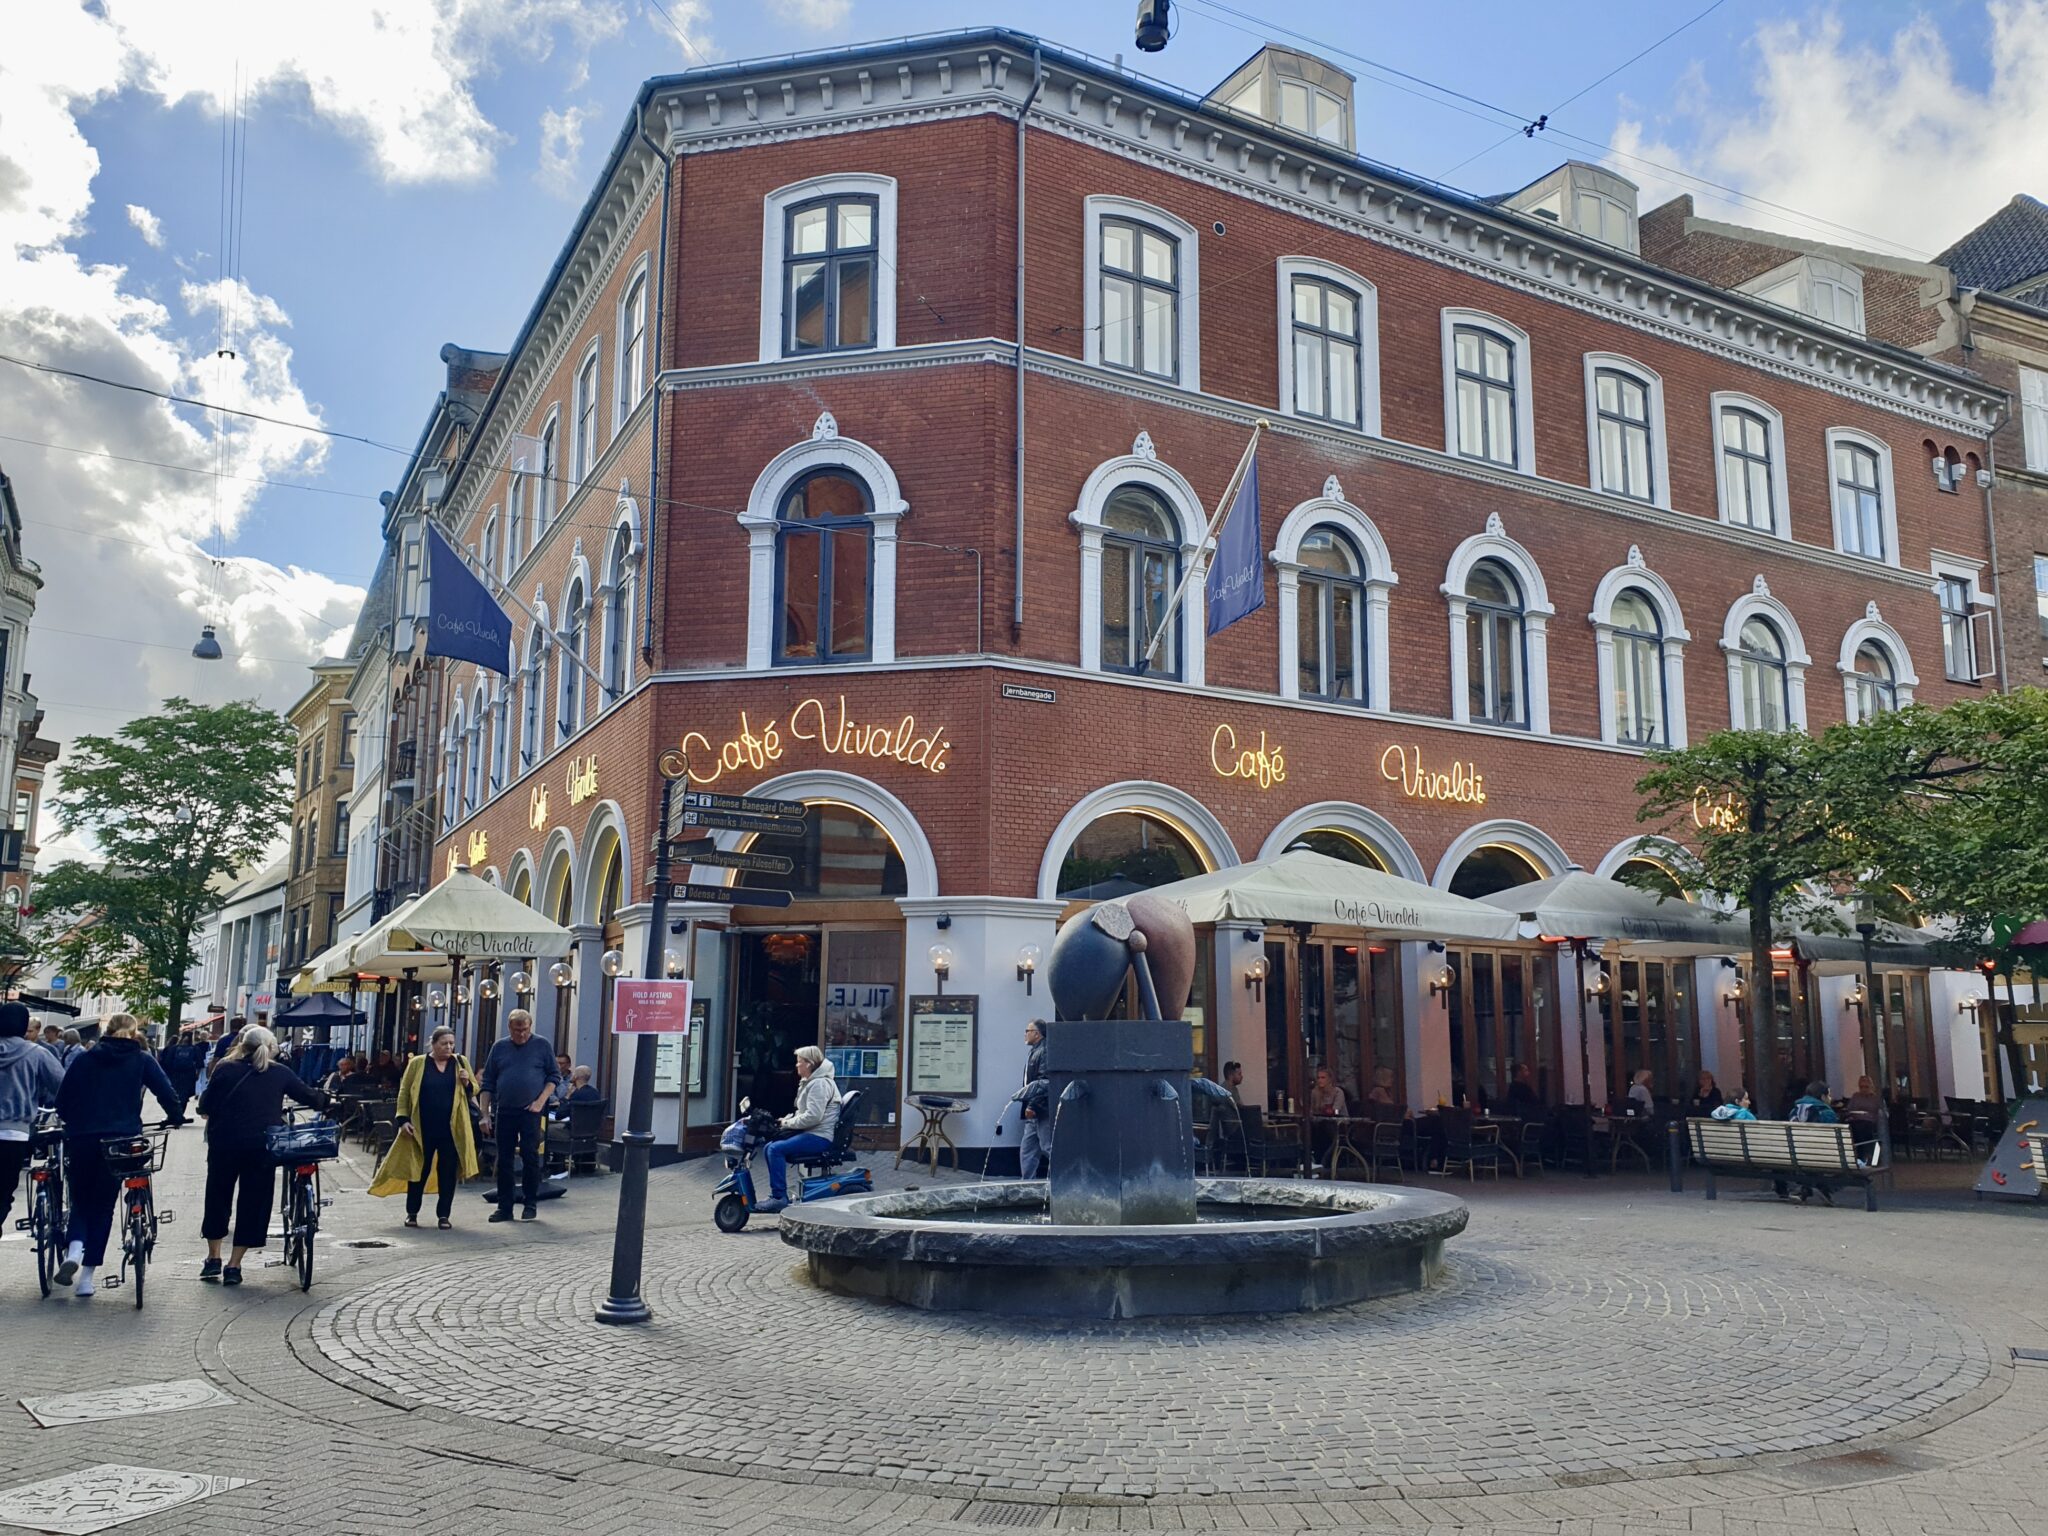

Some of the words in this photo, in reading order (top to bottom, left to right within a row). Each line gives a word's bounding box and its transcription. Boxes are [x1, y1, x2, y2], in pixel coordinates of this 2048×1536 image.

[682, 711, 783, 783] Café
[1211, 723, 1285, 789] Café
[712, 796, 739, 808] Odense
[778, 802, 802, 815] Center
[699, 813, 736, 827] Danmarks
[688, 888, 715, 899] Odense
[718, 889, 730, 901] Zoo
[1335, 899, 1367, 925] Café
[431, 931, 468, 954] Café
[632, 991, 648, 999] HOLD
[649, 991, 673, 999] AFSTAND
